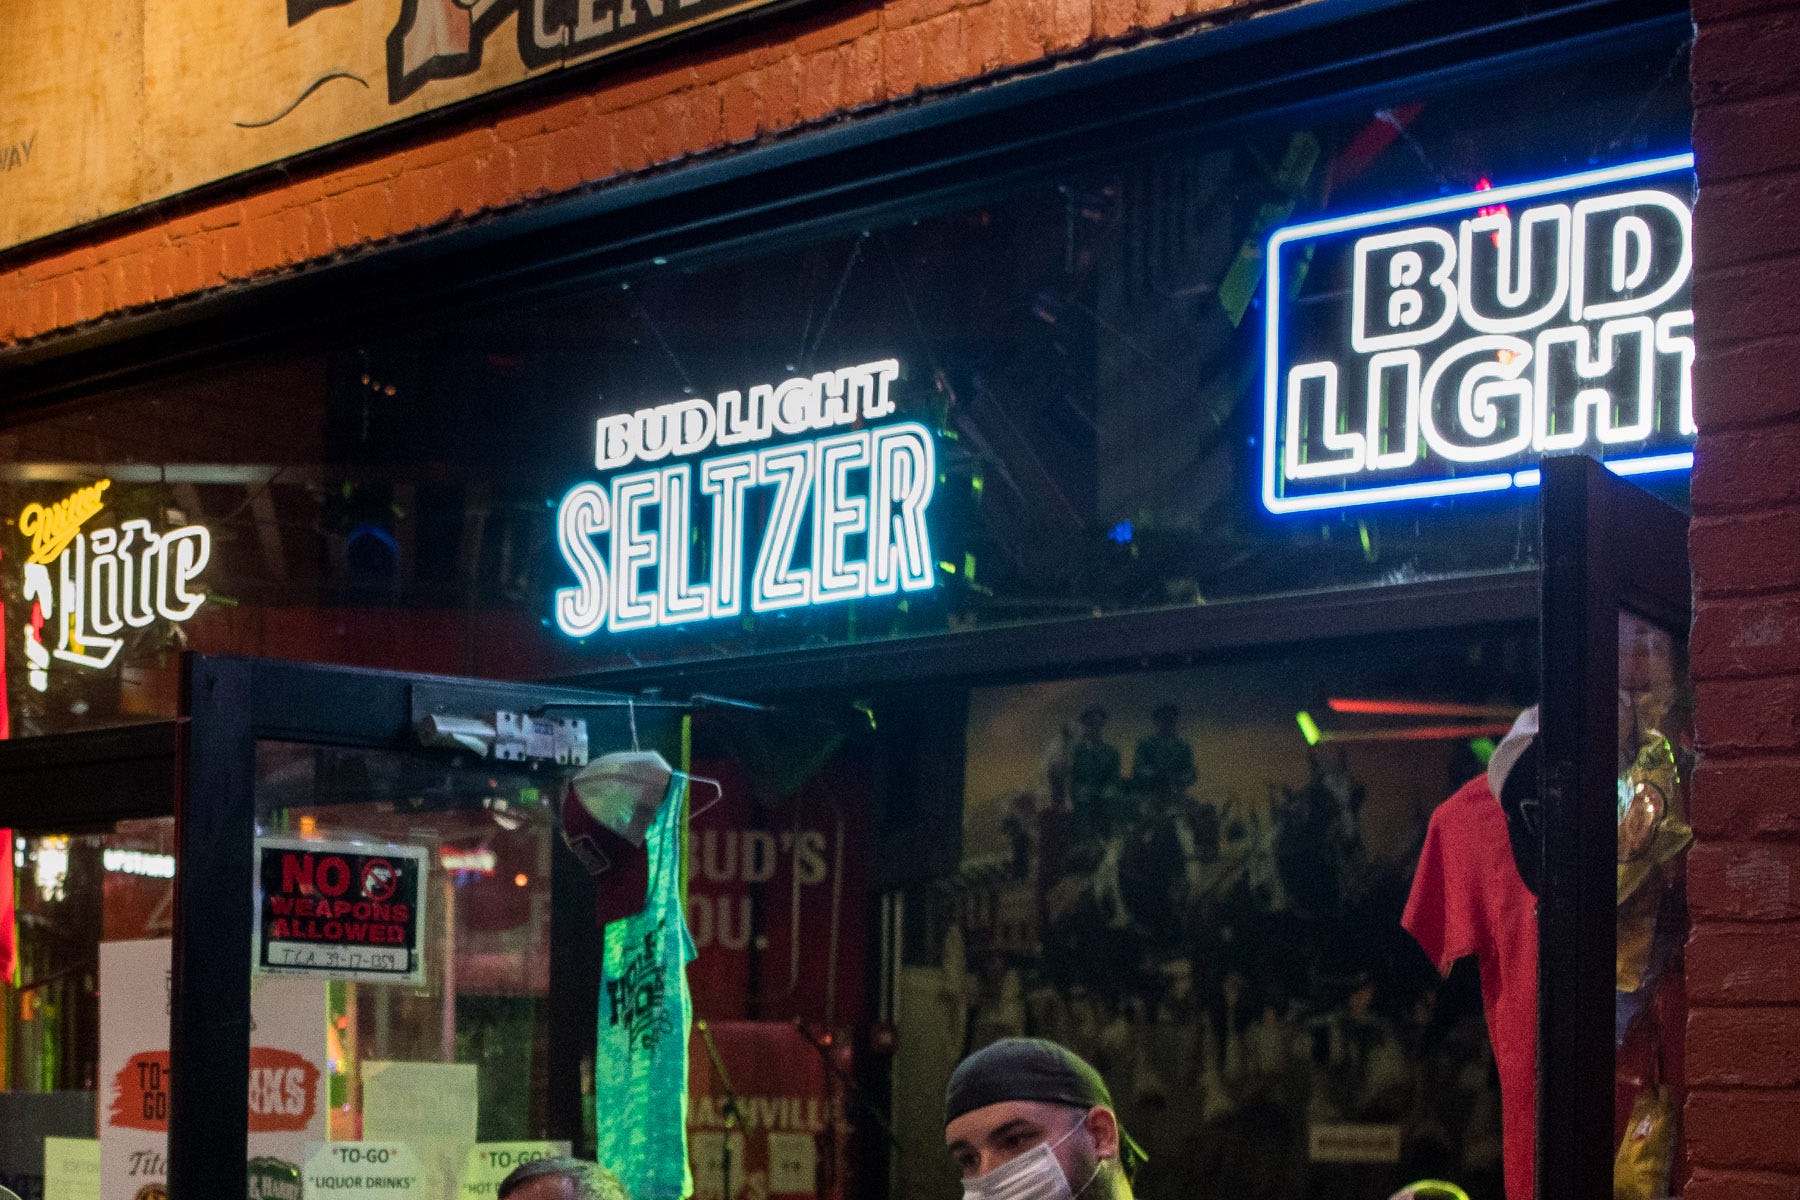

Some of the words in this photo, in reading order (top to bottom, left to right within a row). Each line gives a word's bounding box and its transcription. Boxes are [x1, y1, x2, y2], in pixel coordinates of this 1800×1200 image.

[1352, 190, 1692, 353] BUD
[596, 397, 716, 470] BUD
[716, 358, 899, 447] LIGHT
[555, 421, 935, 638] SELTZER
[281, 853, 351, 897] NO
[270, 895, 410, 923] WEAPONS
[689, 894, 770, 951] OU.
[270, 917, 407, 944] ALLOWED
[143, 1092, 167, 1121] GO
[689, 1097, 835, 1133] AHVILL
[129, 1149, 168, 1176] Tit
